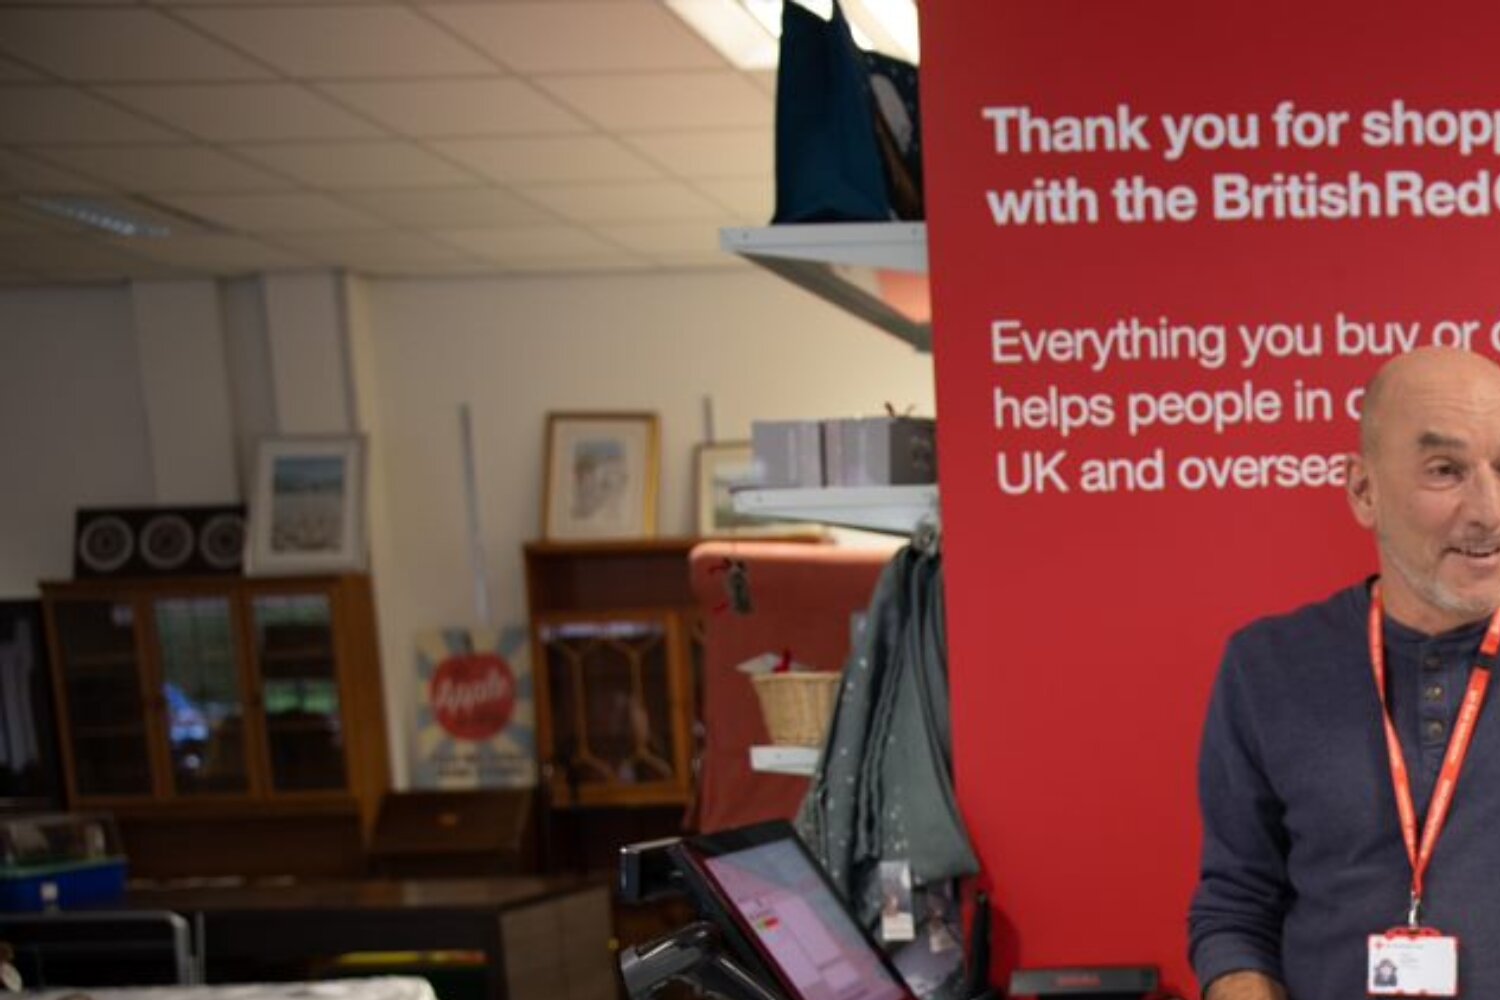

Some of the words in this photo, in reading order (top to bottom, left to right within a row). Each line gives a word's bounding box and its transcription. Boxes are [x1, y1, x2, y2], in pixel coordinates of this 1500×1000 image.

[982, 105, 1149, 153] Thank
[1163, 114, 1258, 160] you
[1272, 102, 1348, 148] for
[987, 178, 1098, 225] with
[1113, 177, 1197, 221] the
[992, 319, 1226, 371] Everything
[1240, 325, 1322, 367] you
[1336, 312, 1420, 355] buy
[1432, 320, 1481, 350] or
[994, 387, 1114, 435] helps
[1127, 382, 1281, 434] people
[1294, 378, 1333, 421] in
[997, 451, 1069, 494] UK
[1079, 448, 1164, 491] and
[1177, 453, 1348, 490] oversea
